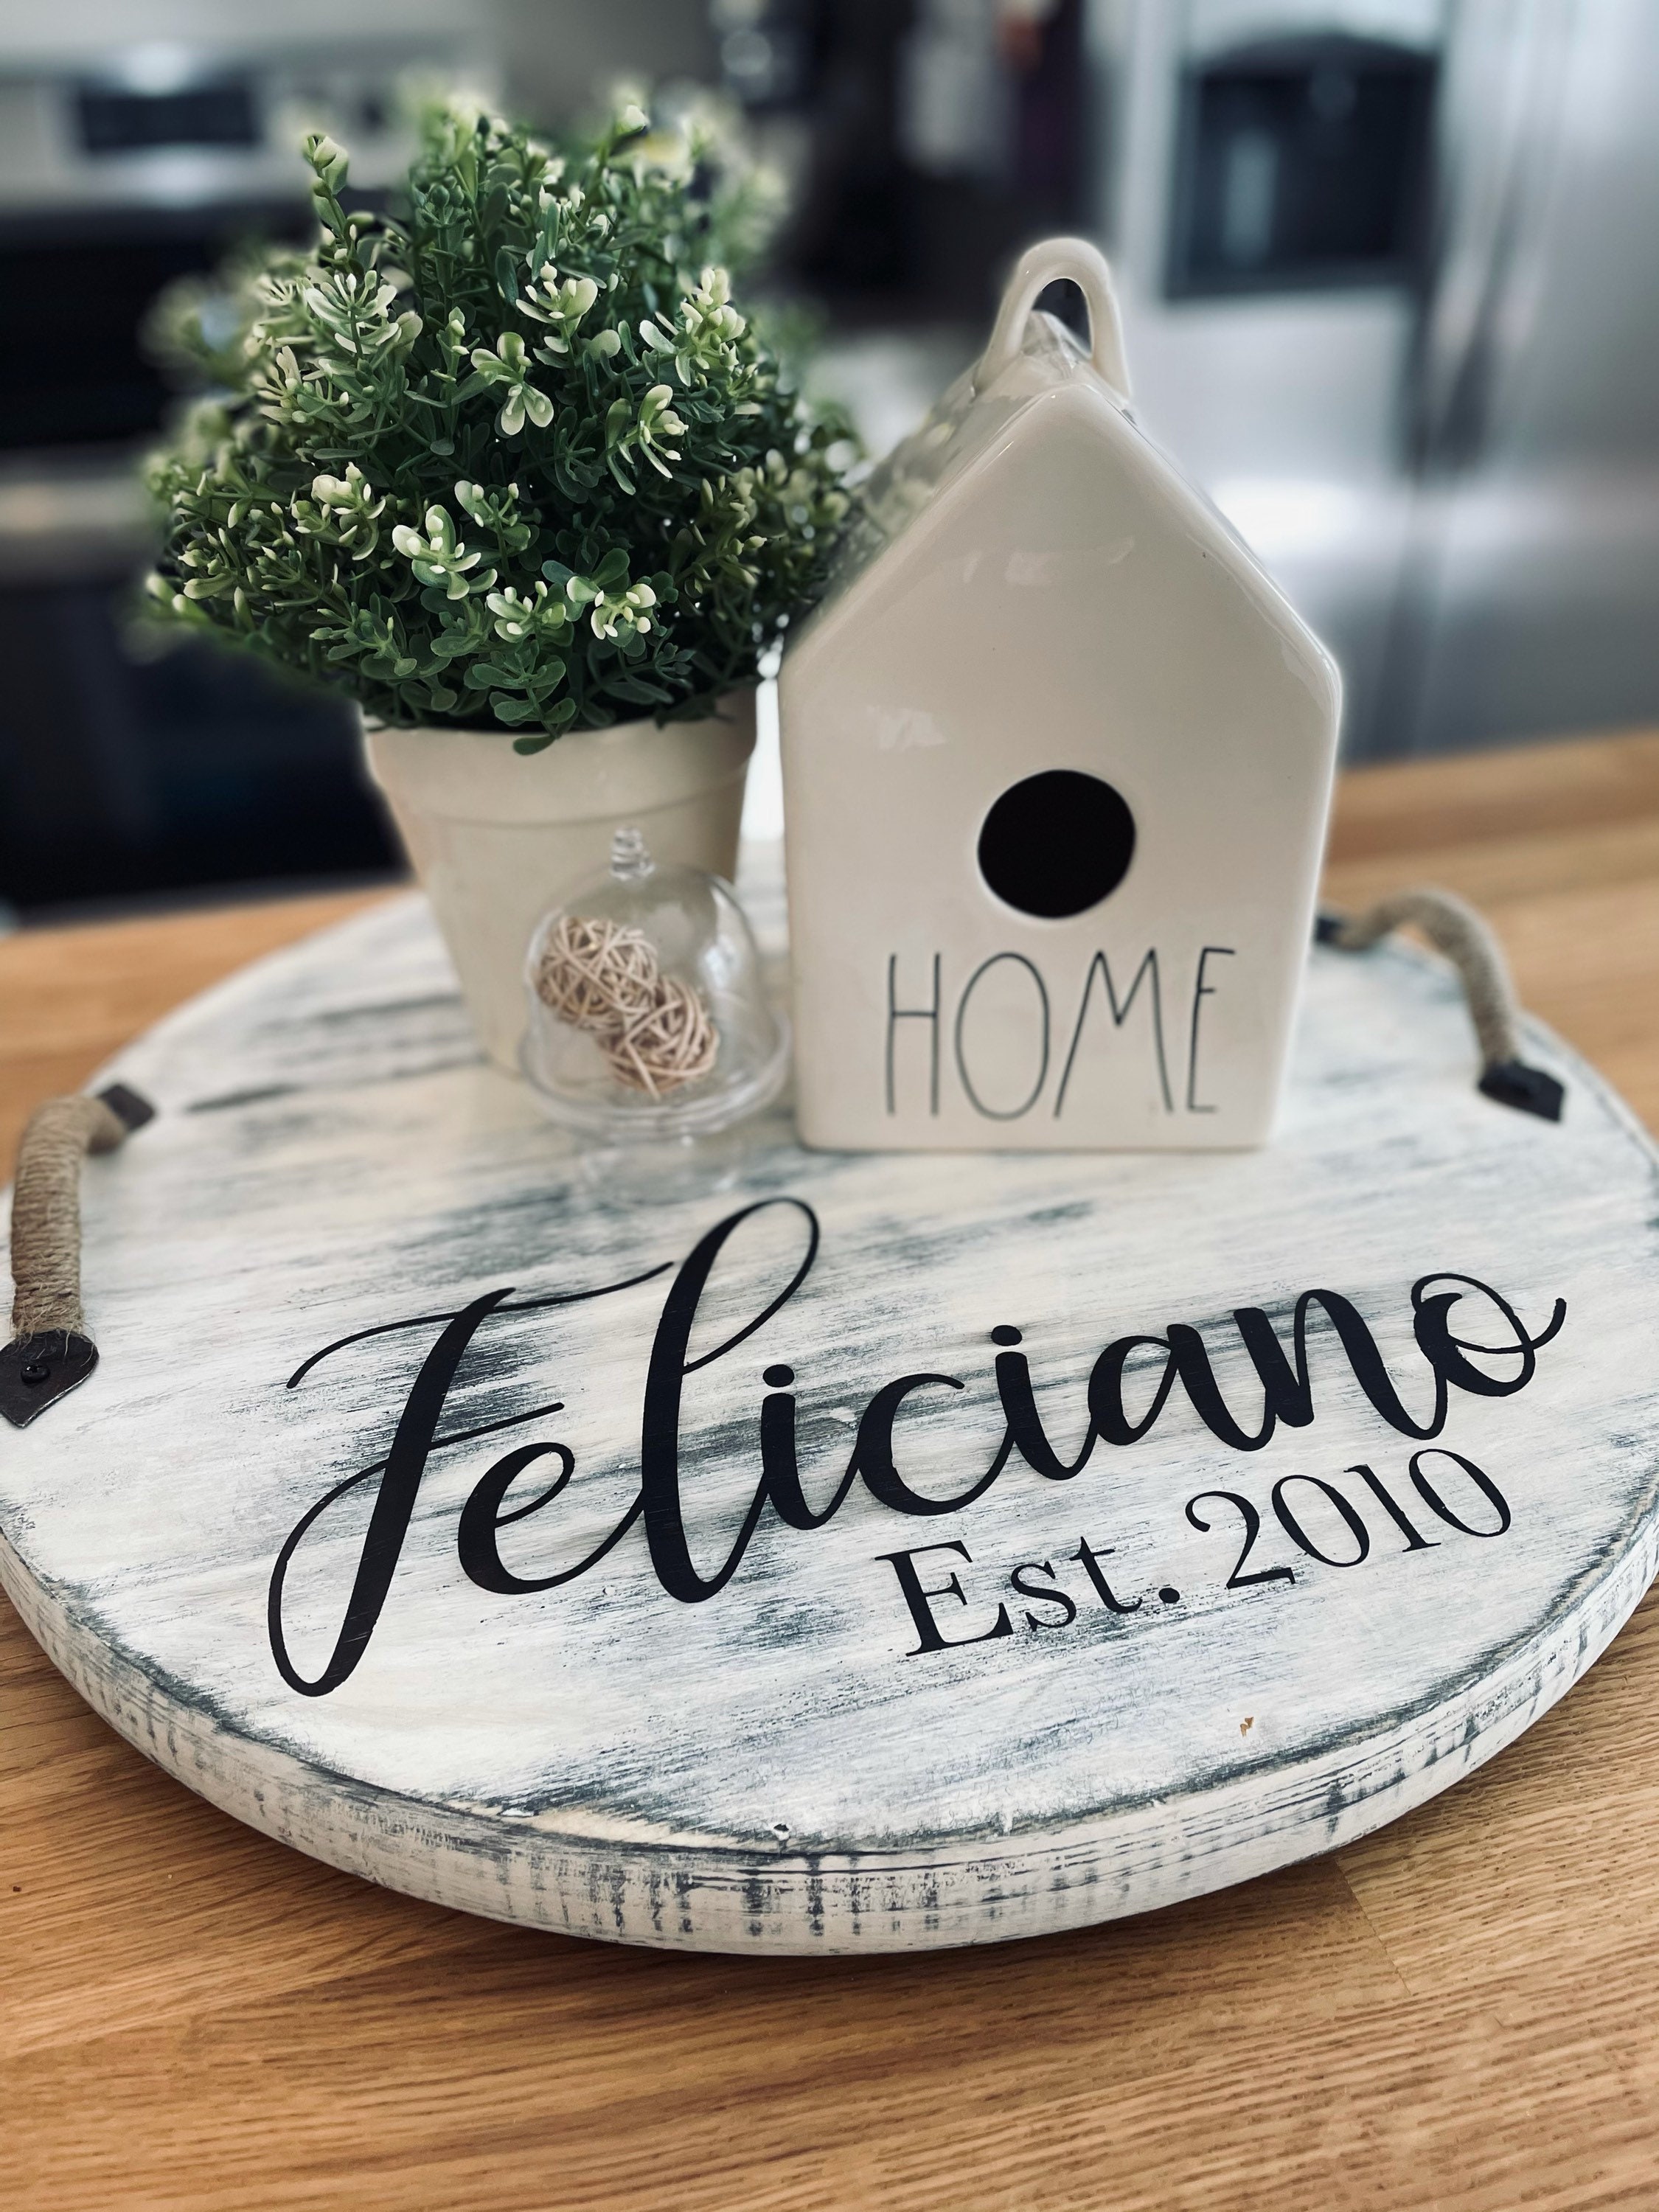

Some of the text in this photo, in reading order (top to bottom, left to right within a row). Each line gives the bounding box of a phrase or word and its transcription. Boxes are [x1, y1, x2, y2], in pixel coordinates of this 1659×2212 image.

[886, 947, 1237, 1121] HOME
[268, 1197, 1567, 1697] Feliciano
[874, 1448, 1512, 1657] Est. 2010
